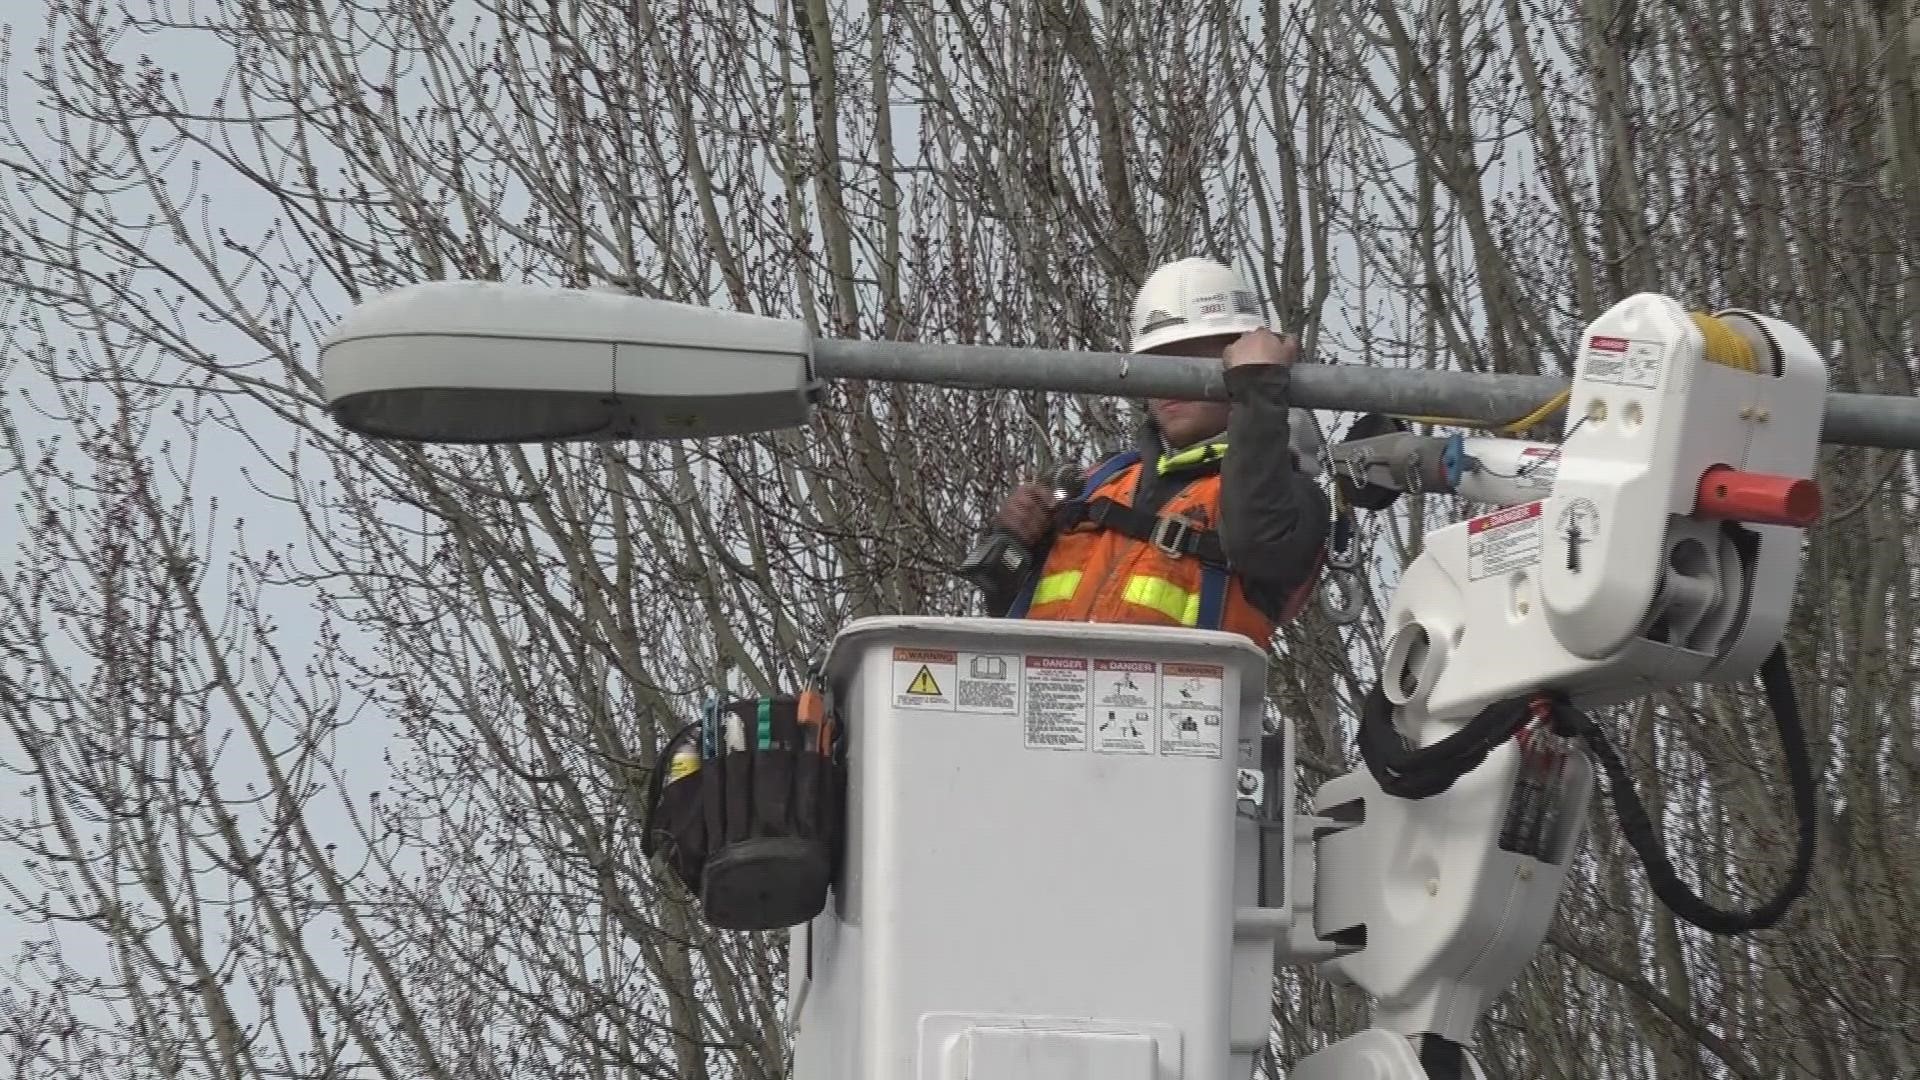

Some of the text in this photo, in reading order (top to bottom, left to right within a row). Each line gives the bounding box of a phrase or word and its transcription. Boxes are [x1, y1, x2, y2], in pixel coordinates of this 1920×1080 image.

[1488, 507, 1529, 526] DANGER
[1042, 658, 1083, 669] DANGER
[1109, 661, 1152, 672] DANGER
